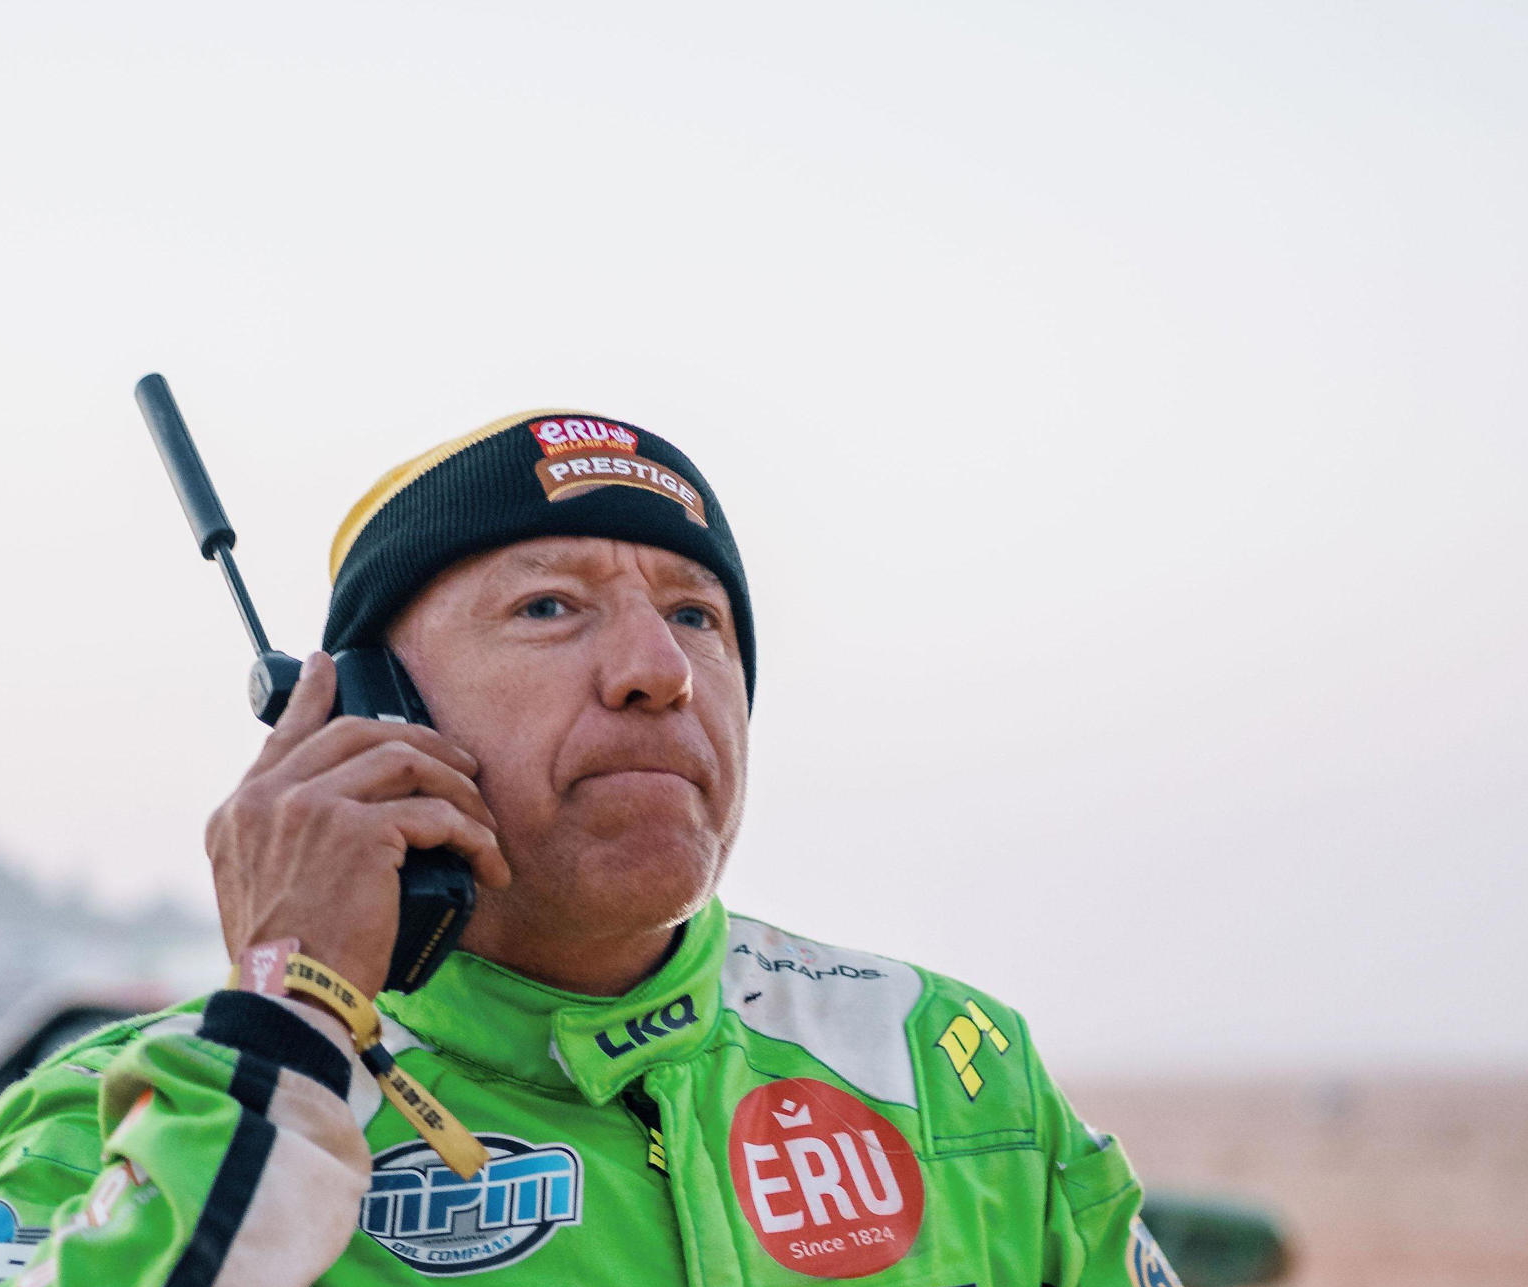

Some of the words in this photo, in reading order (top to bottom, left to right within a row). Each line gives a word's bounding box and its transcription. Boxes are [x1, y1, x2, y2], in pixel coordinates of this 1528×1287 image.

[547, 456, 697, 507] PRESTIGE
[594, 994, 699, 1060] LKQ
[743, 1129, 904, 1234] ERU
[392, 1242, 420, 1259] OIL
[427, 1234, 513, 1262] COMPANY
[789, 1237, 846, 1260] Since
[848, 1226, 896, 1247] 1824
